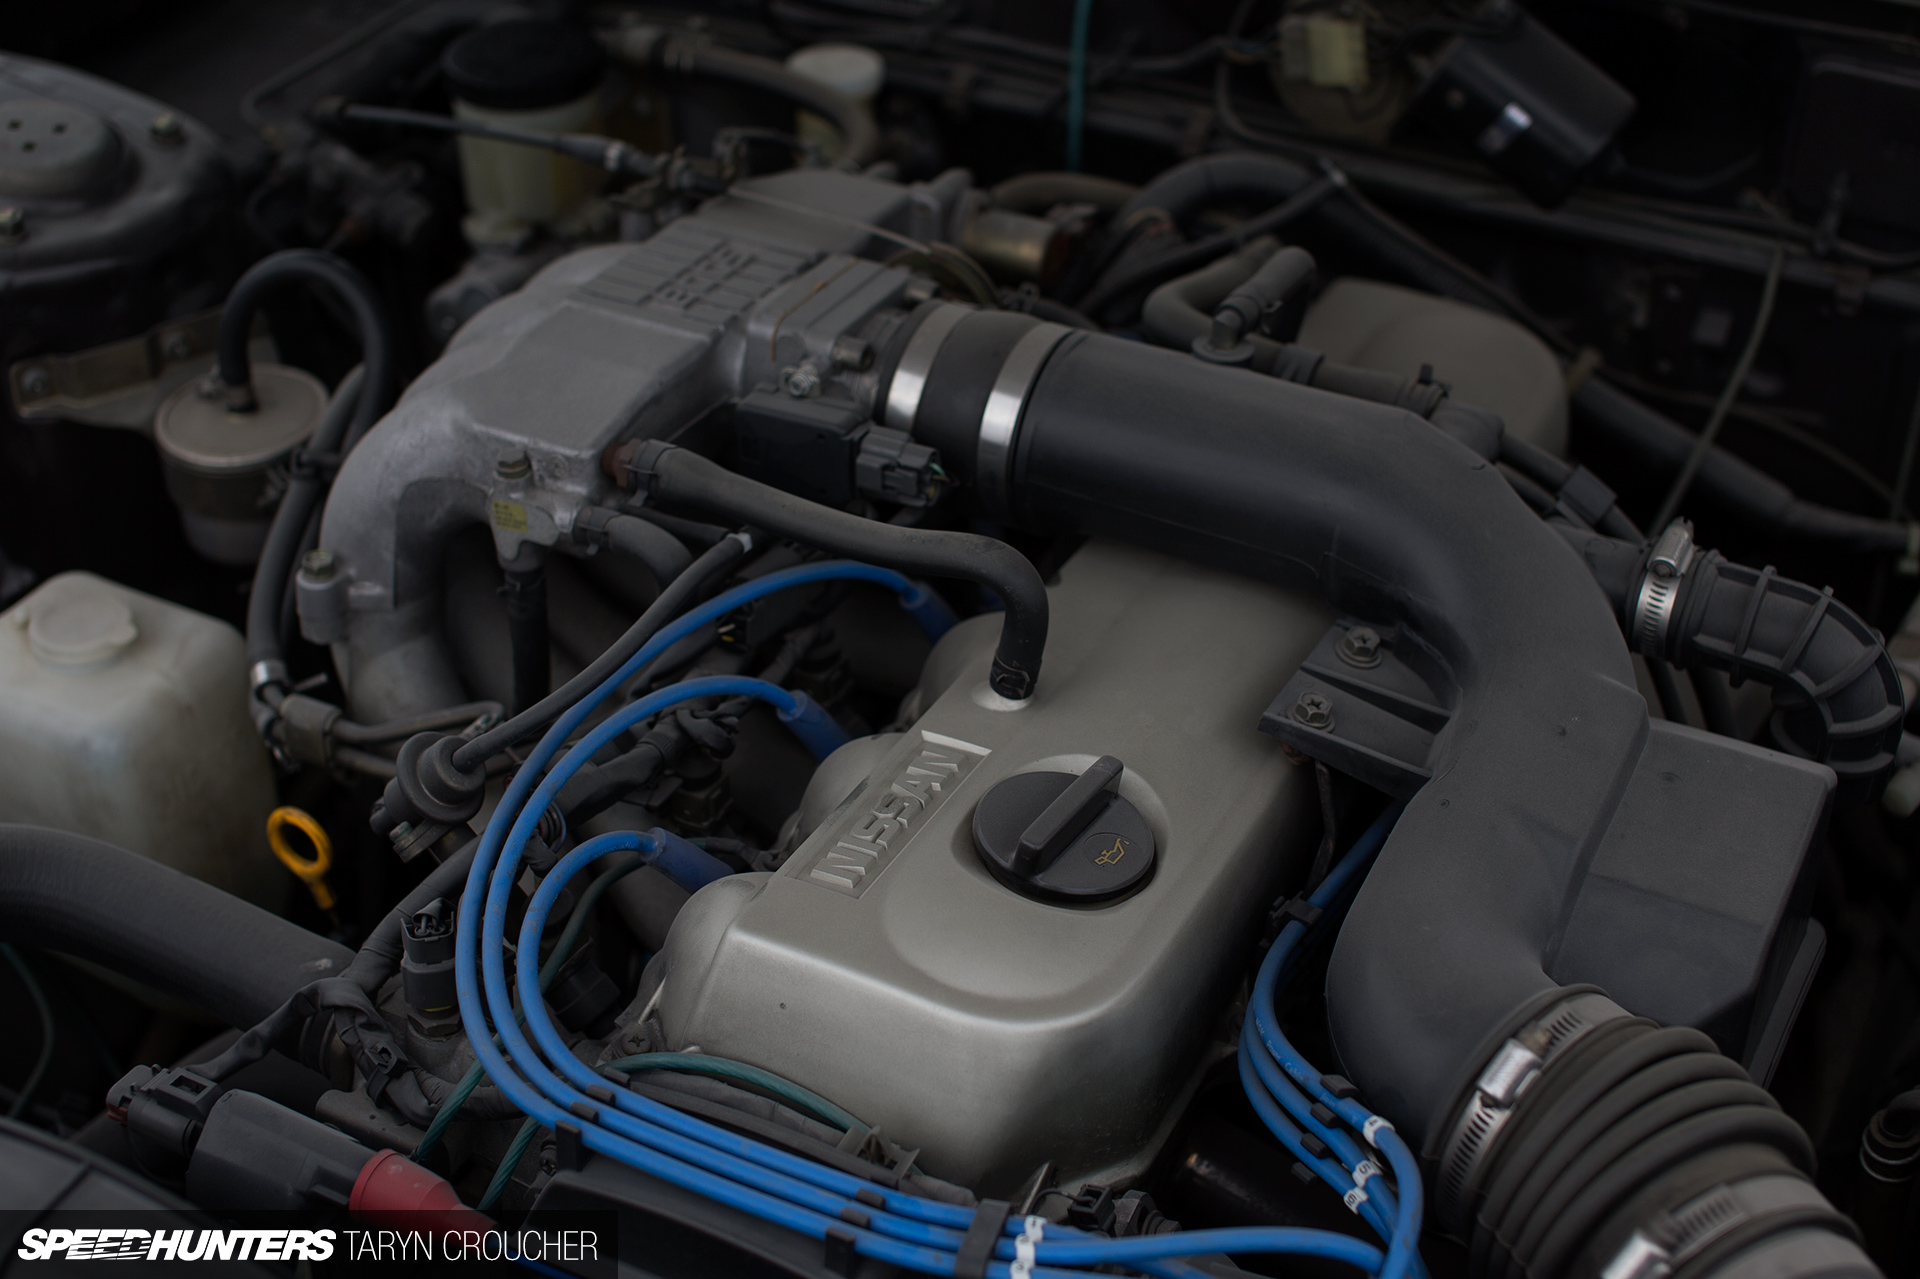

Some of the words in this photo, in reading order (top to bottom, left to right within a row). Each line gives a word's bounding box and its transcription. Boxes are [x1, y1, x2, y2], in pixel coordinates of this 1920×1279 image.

[810, 750, 967, 888] NISSAN
[1358, 1162, 1372, 1175] 5
[1346, 1192, 1357, 1206] 6
